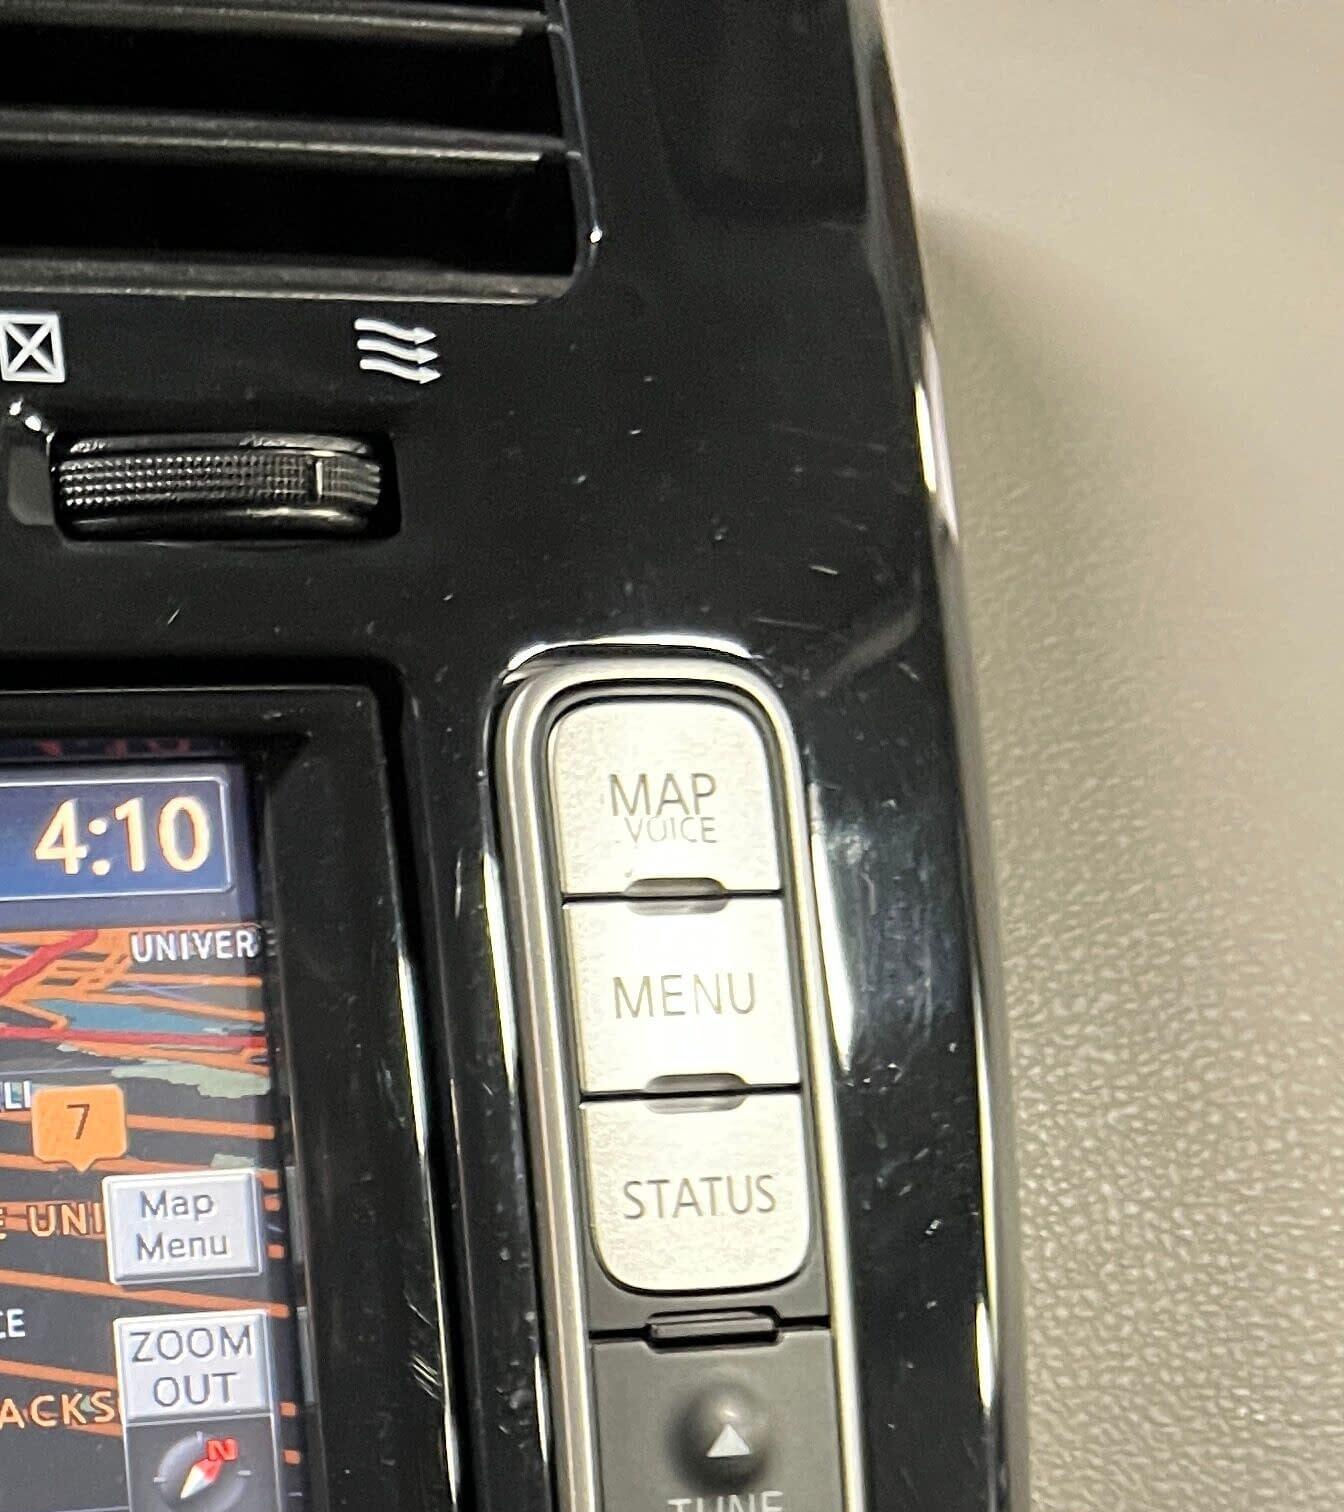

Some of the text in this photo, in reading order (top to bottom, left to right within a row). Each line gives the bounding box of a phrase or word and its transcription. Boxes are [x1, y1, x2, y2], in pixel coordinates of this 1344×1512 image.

[609, 772, 717, 817] MAP
[34, 795, 211, 876] 4:10
[624, 815, 717, 844] VOICE
[613, 972, 755, 1019] MENU
[66, 1103, 91, 1141] 7
[140, 1191, 215, 1222] Map
[623, 1174, 776, 1220] STATUS
[136, 1232, 229, 1261] Menu
[129, 1326, 253, 1363] ZOOM
[153, 1372, 237, 1407] OUT
[205, 1438, 238, 1462] N
